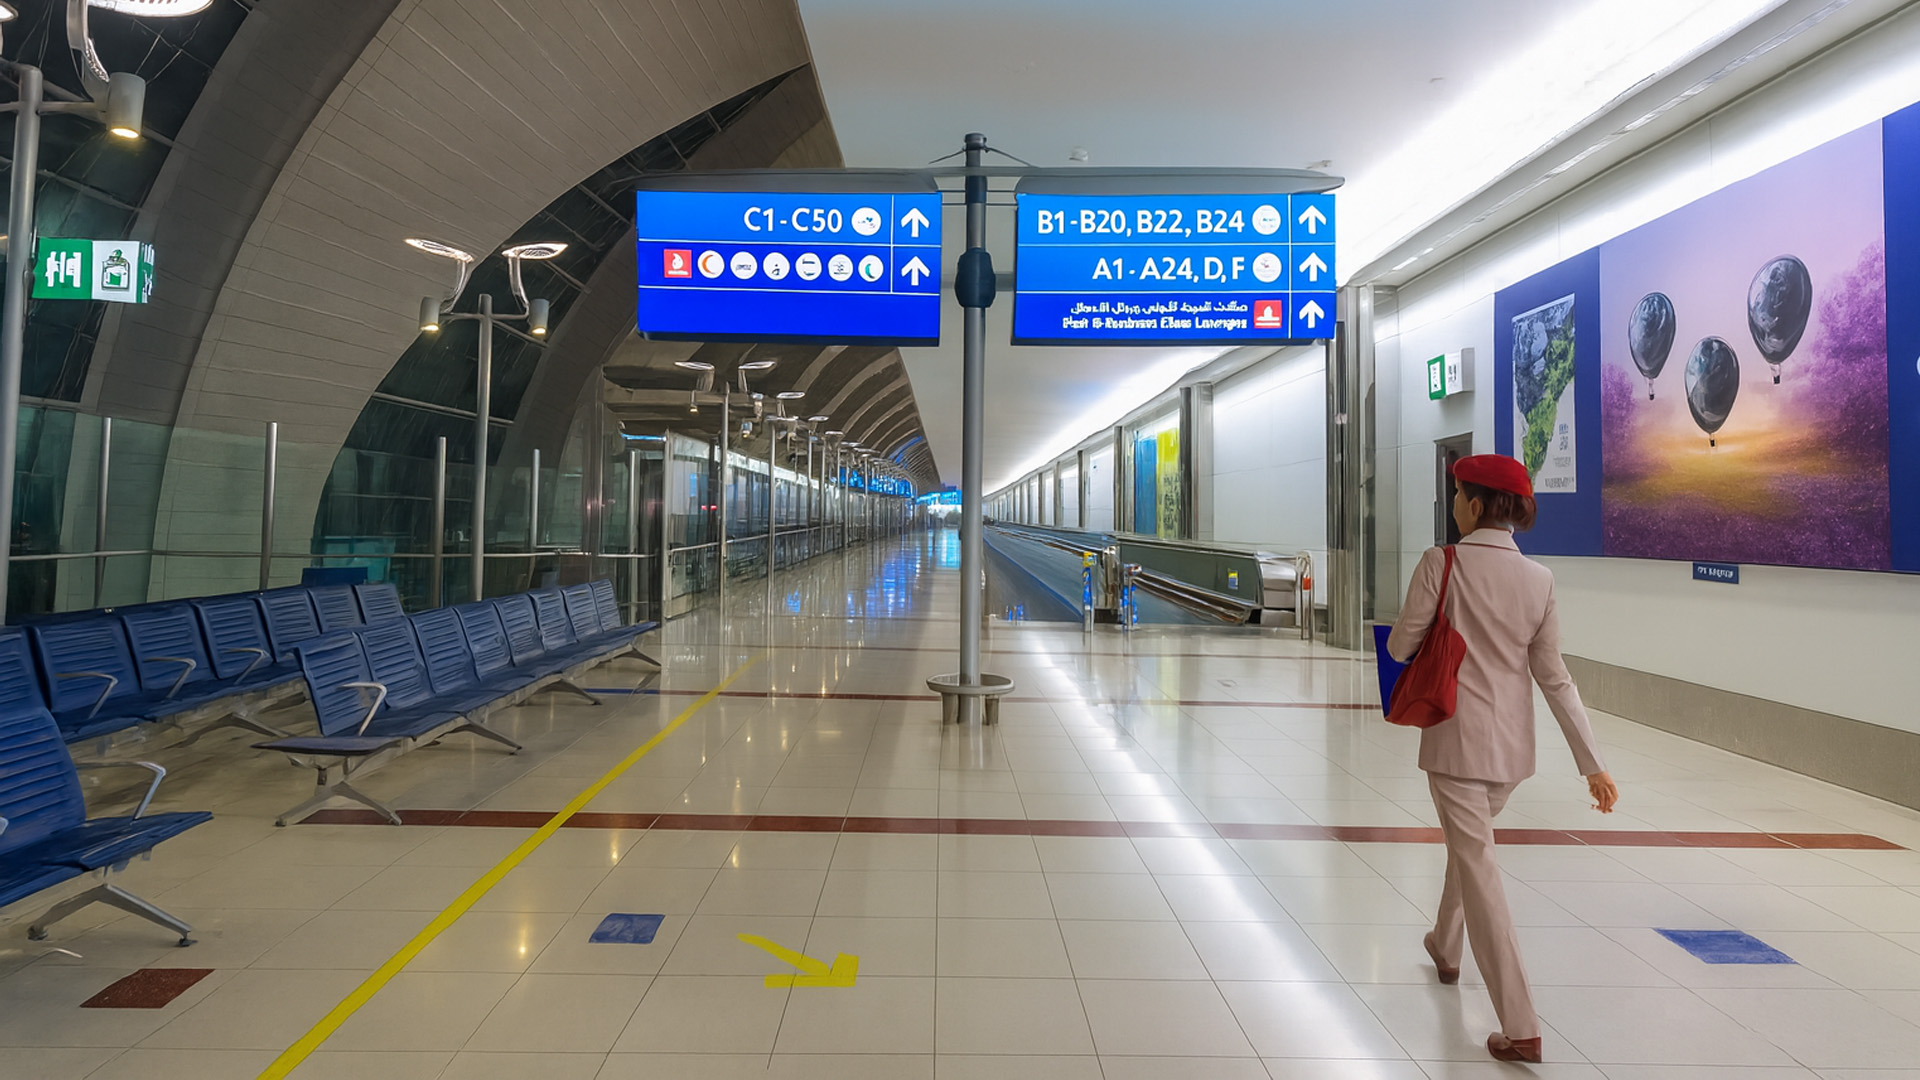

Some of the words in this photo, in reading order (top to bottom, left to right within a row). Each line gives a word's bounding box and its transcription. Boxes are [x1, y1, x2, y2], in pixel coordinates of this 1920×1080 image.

[1137, 209, 1192, 238] B22,
[1196, 209, 1245, 234] B24
[1232, 256, 1245, 280] F
